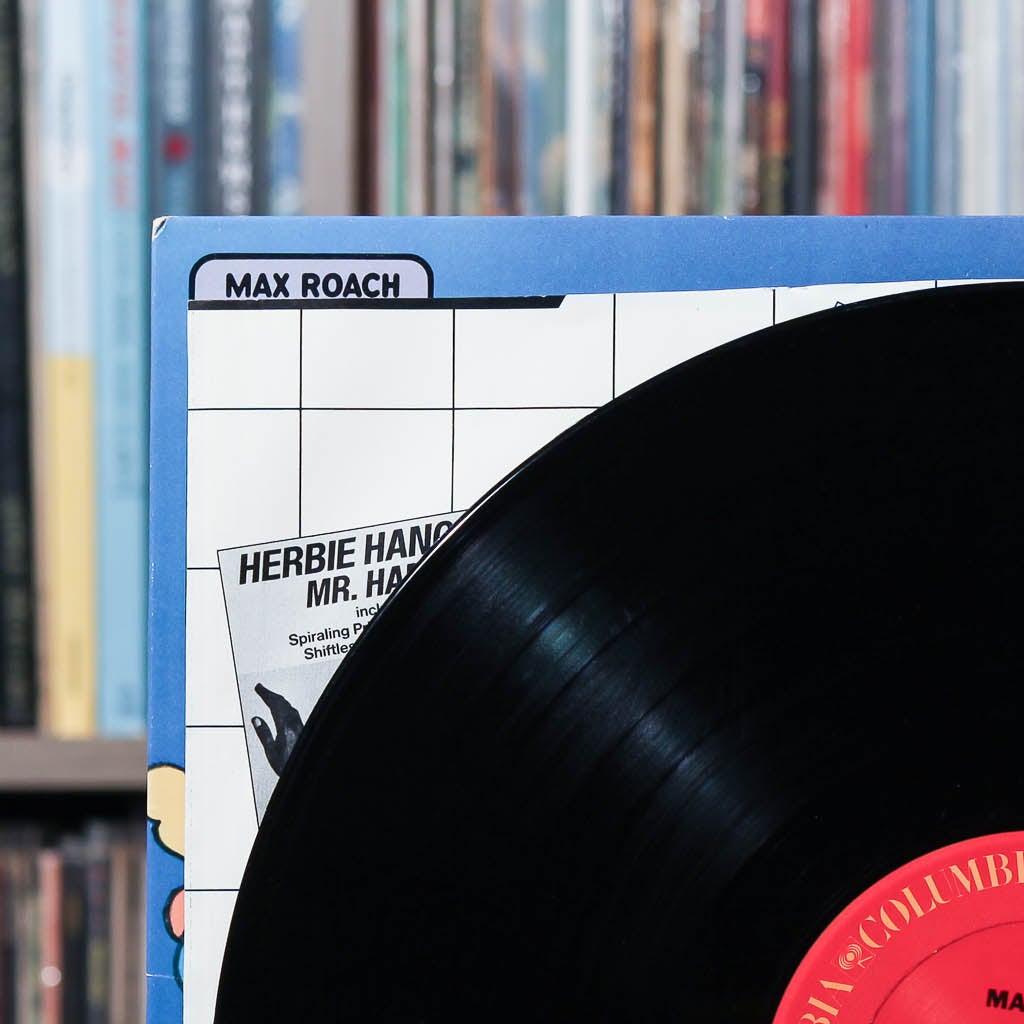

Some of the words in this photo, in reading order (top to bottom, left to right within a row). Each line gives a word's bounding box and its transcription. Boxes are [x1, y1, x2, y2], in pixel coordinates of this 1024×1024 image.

[225, 272, 290, 299] MAX
[301, 272, 401, 299] ROACH
[239, 537, 356, 585] HERBIE
[306, 575, 357, 608] MR.
[288, 624, 350, 647] Spiraling
